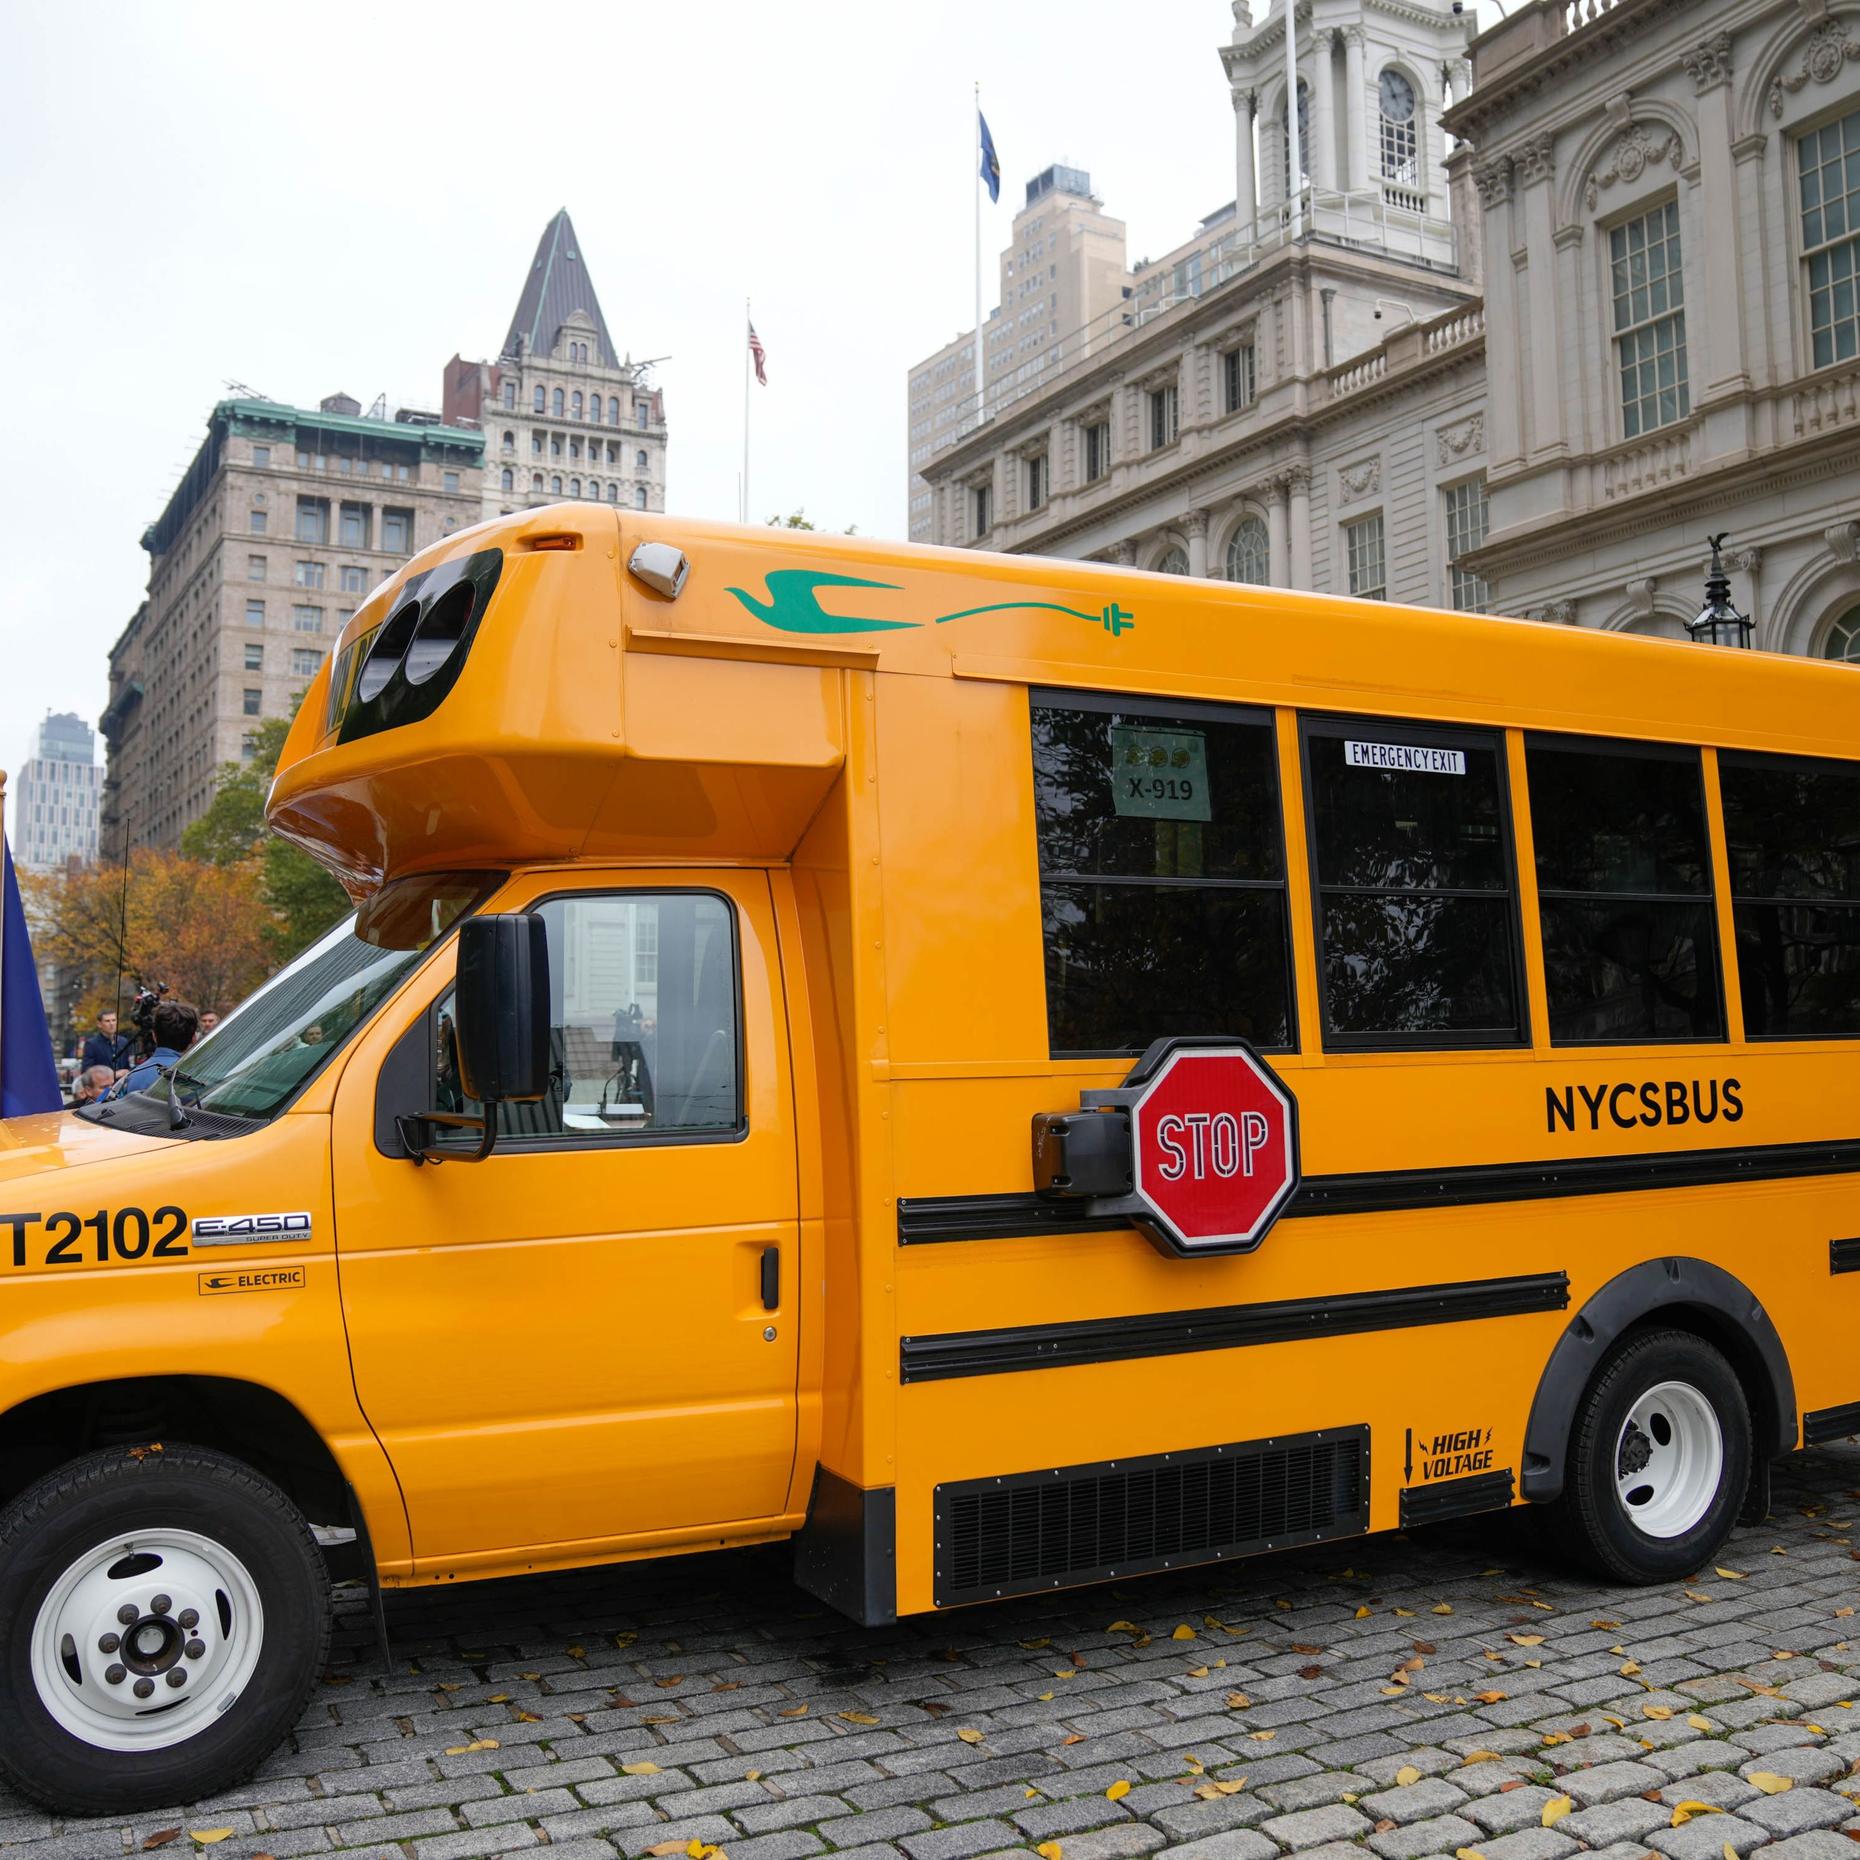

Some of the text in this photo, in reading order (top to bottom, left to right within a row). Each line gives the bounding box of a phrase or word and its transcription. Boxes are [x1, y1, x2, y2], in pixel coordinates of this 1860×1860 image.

[1352, 744, 1457, 772] EMERGENCY EXIT
[1129, 778, 1193, 800] X-919
[1545, 1078, 1744, 1132] NYCSBUS
[1156, 1111, 1268, 1181] STOP
[0, 1206, 189, 1266] T2102
[195, 1215, 309, 1236] E-450
[246, 1234, 279, 1242] SUPER
[238, 1272, 301, 1287] ELECTRIC
[1432, 1429, 1482, 1455] HIGH
[1423, 1450, 1494, 1480] VOLTAGE
